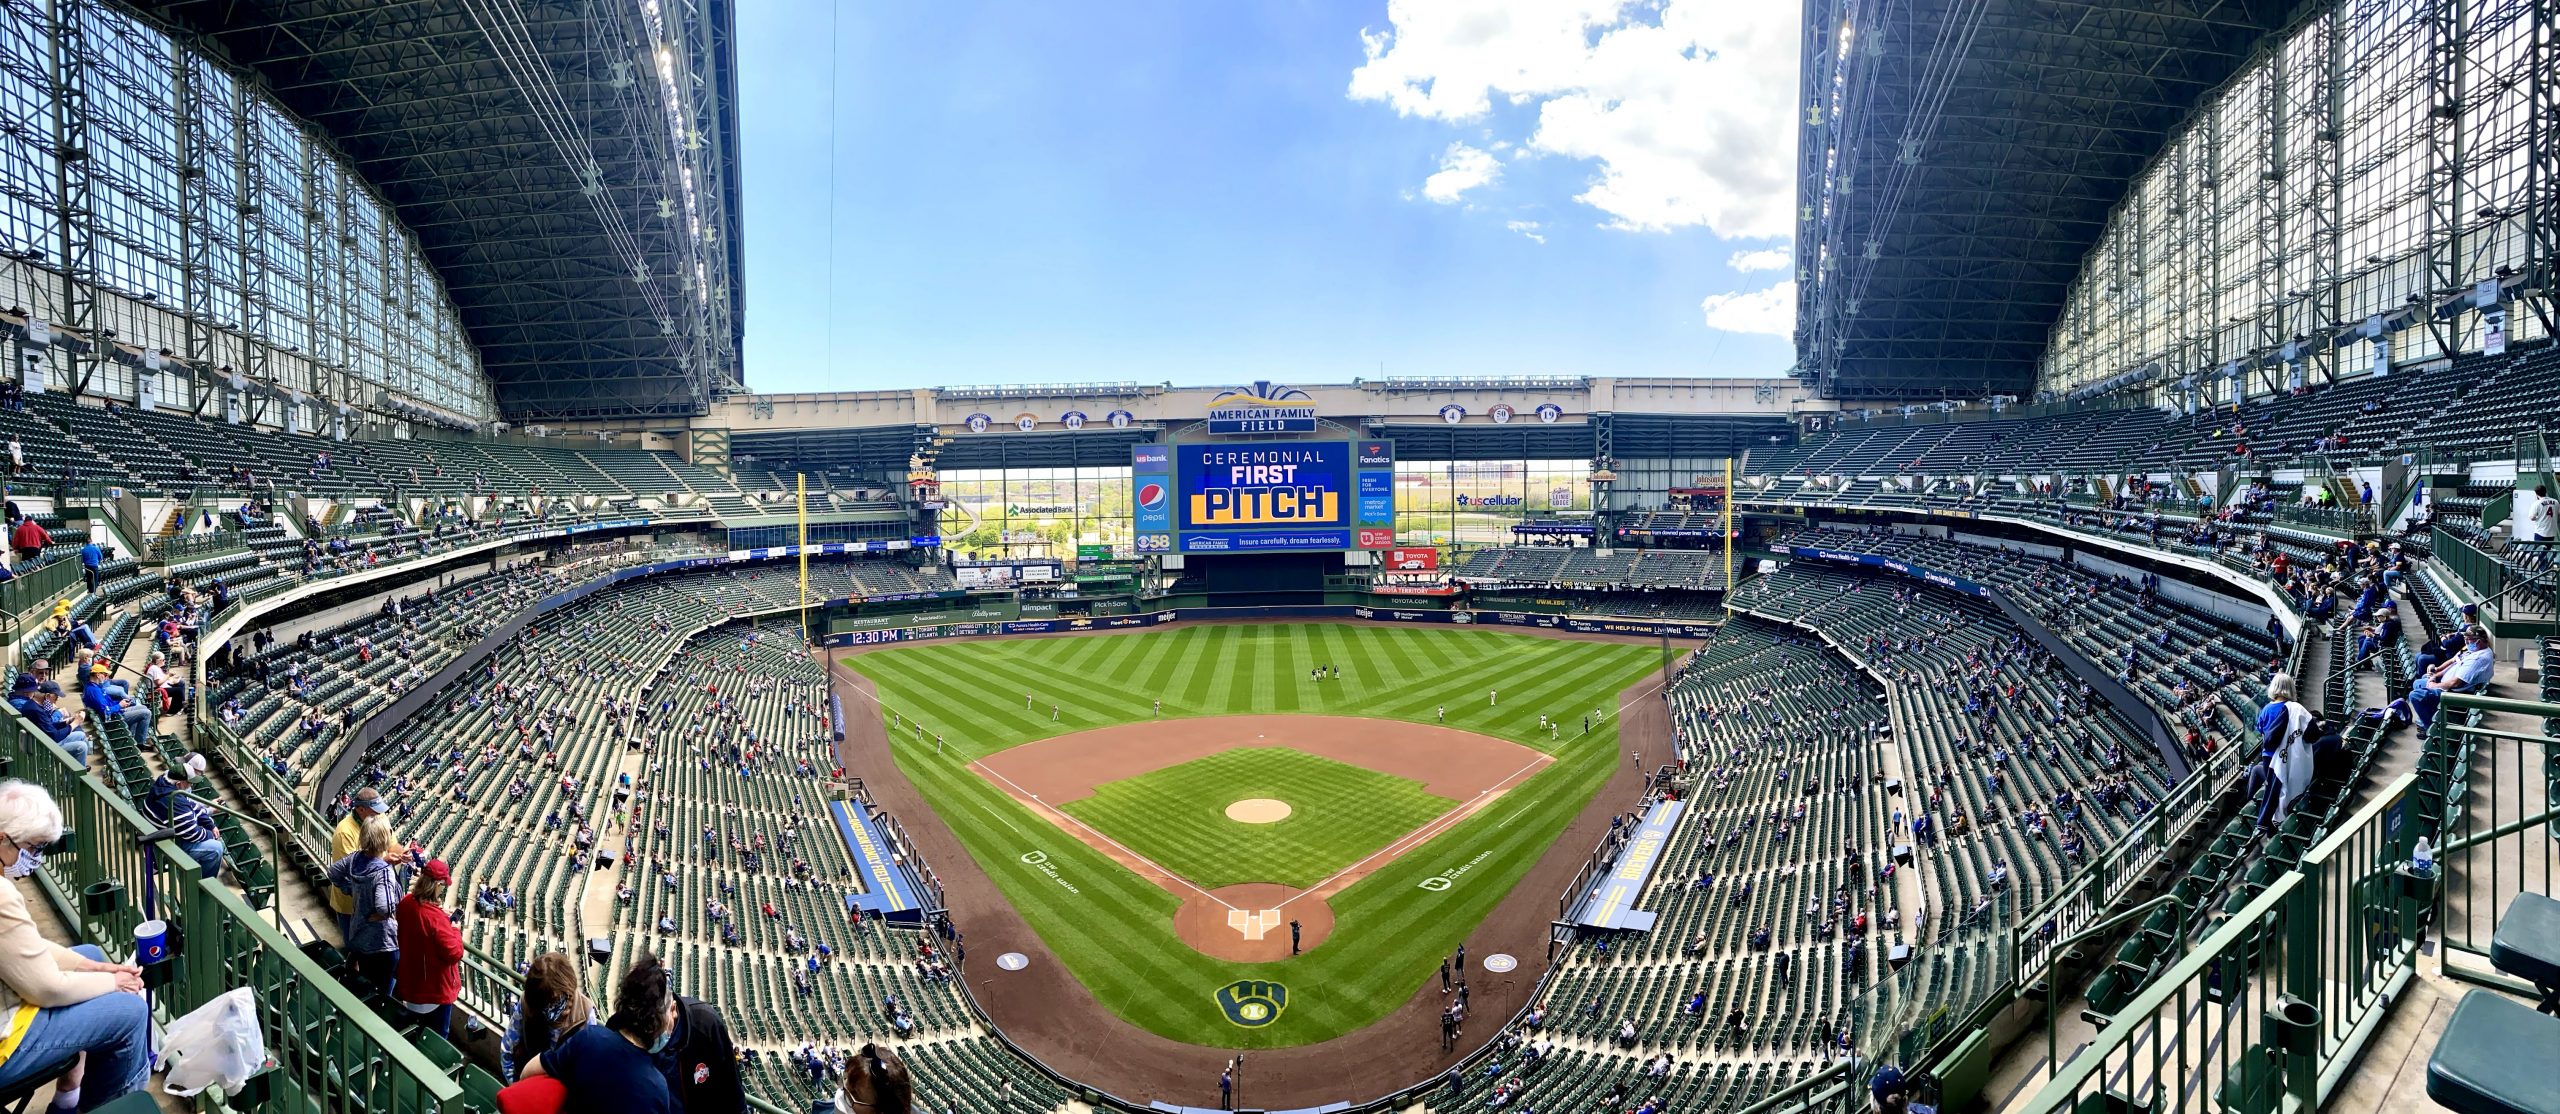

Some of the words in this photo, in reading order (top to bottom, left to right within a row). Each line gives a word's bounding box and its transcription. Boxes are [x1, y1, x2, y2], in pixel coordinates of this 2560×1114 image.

[1210, 409, 1270, 420] AMERICAN
[1274, 408, 1315, 418] FAMILY
[973, 420, 984, 429] 34
[1020, 420, 1032, 428] 42
[1242, 420, 1284, 431] FIELD
[1203, 451, 1324, 464] CEREMONIAL
[1232, 465, 1297, 484] FIRST
[1696, 475, 1727, 483] Johnsonvill
[1204, 486, 1324, 520] PITCH
[1142, 514, 1165, 522] pepsi
[2546, 506, 2553, 518] 4
[1149, 535, 1170, 548] 58
[1260, 537, 1288, 545] carefully,
[1310, 536, 1341, 545] fearlessly.
[1158, 613, 1176, 622] meijer
[1356, 608, 1373, 618] meijer
[853, 632, 878, 644] 12:30
[882, 630, 898, 641] PM
[860, 843, 882, 864] FAMILY
[871, 864, 891, 882] FIELD
[1449, 864, 1472, 879] credit
[1469, 851, 1493, 864] union
[1619, 840, 1658, 880] BREWERS
[1441, 868, 1455, 877] uw
[1037, 864, 1058, 878] credit
[1056, 878, 1079, 894] union
